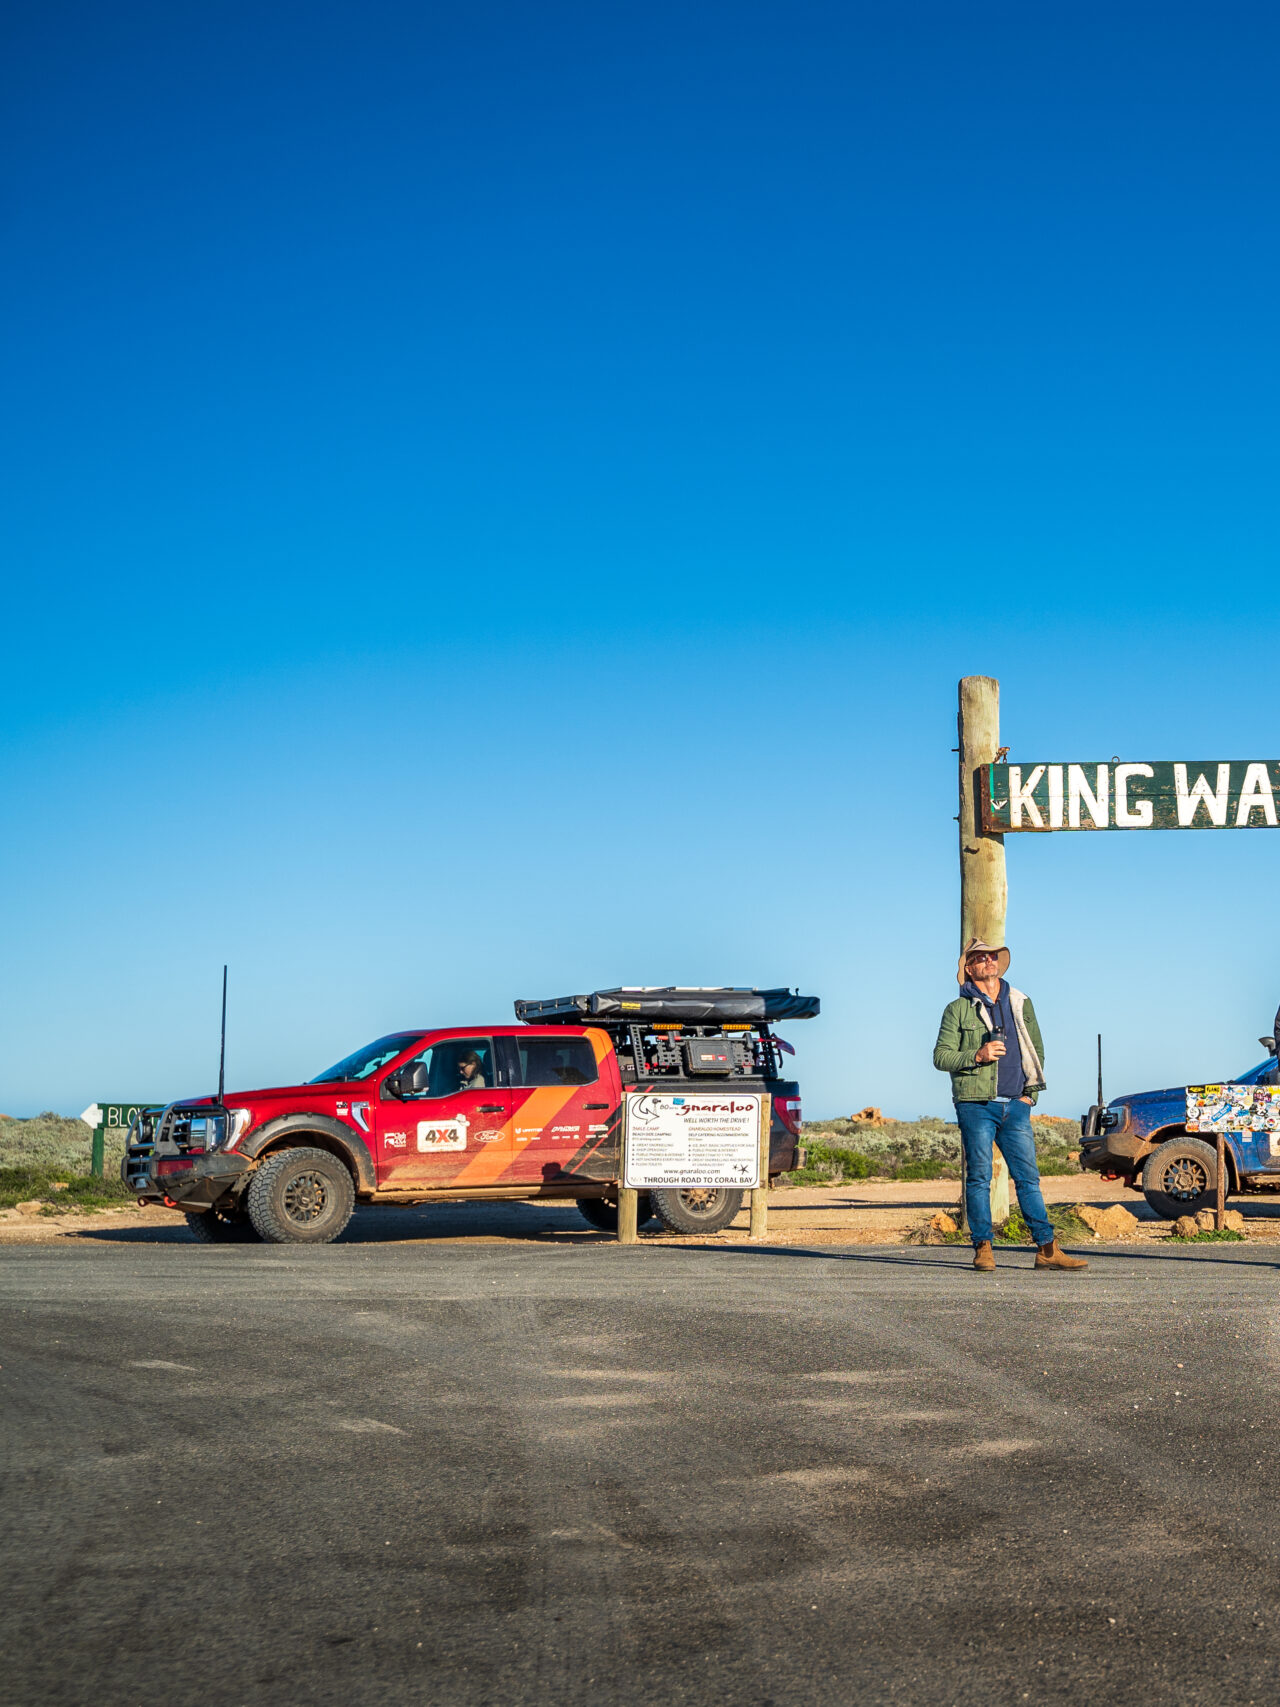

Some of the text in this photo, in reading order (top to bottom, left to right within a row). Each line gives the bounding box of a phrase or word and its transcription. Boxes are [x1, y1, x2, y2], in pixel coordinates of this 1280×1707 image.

[1008, 763, 1154, 828] KING
[676, 1101, 754, 1116] gnaraloo
[426, 1128, 459, 1143] 4X4
[480, 1132, 498, 1140] Ford
